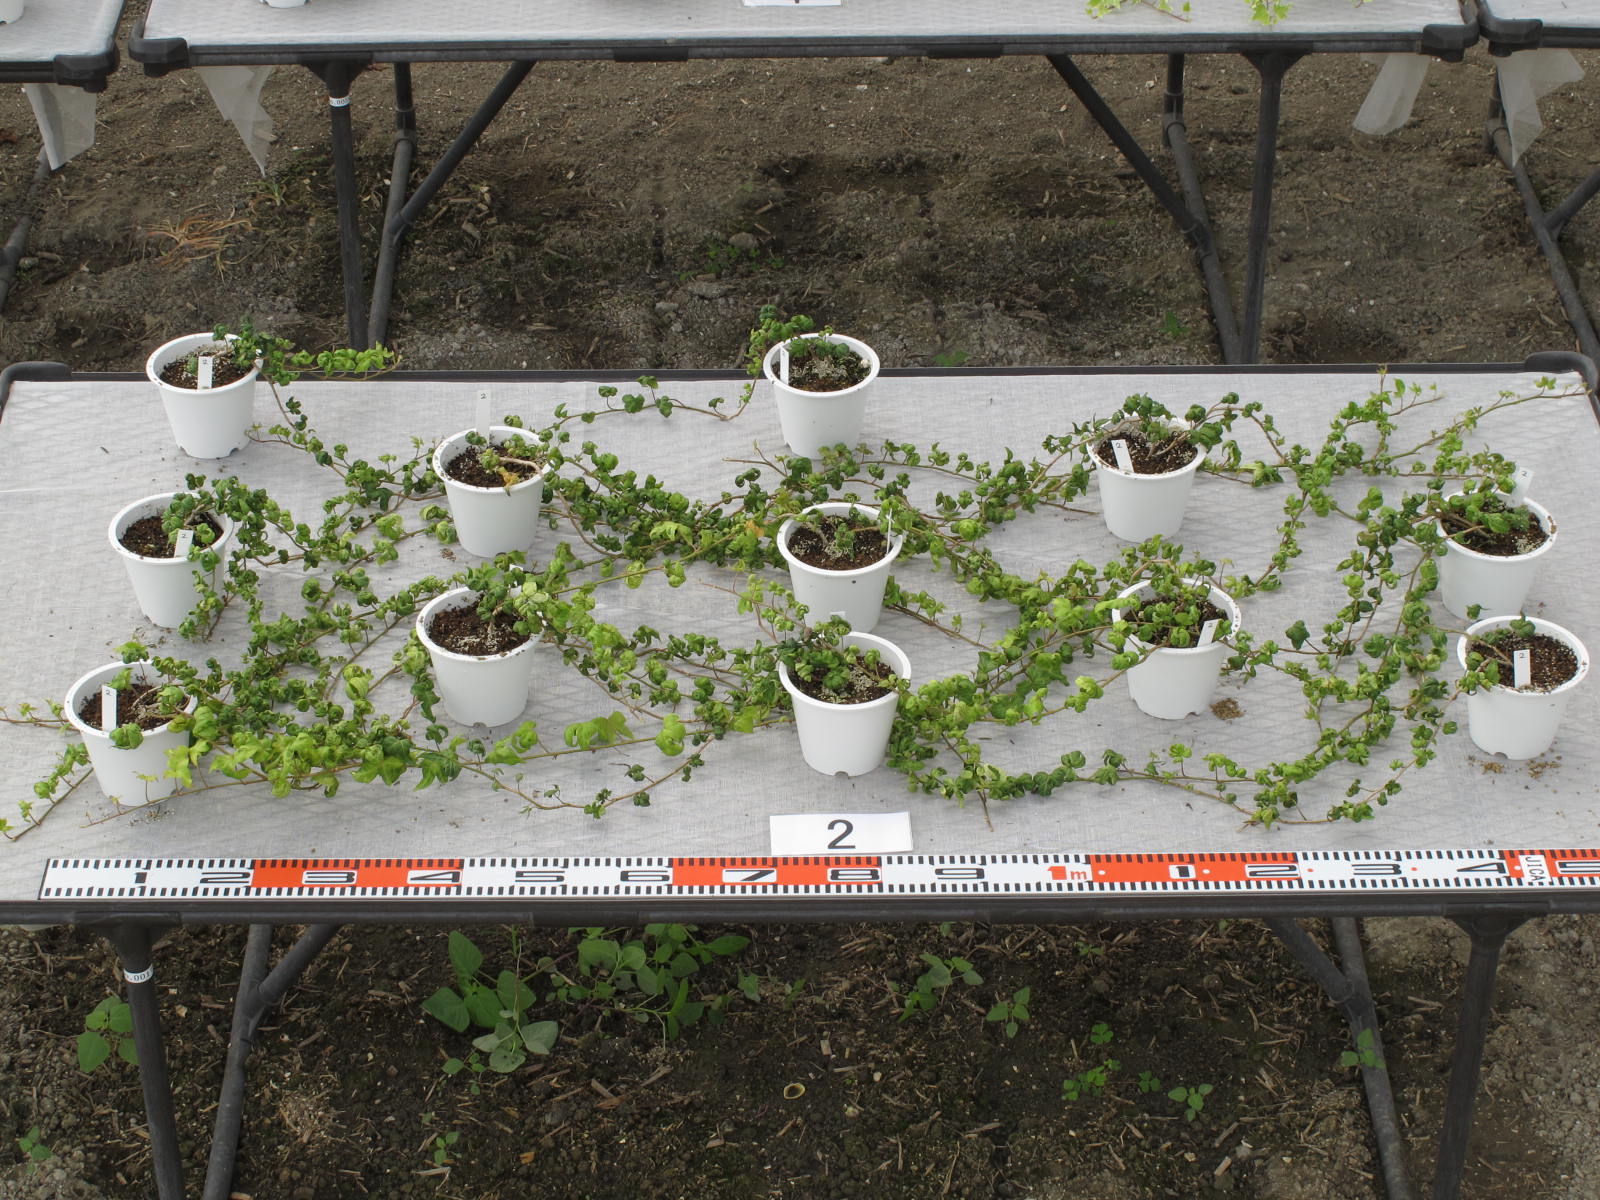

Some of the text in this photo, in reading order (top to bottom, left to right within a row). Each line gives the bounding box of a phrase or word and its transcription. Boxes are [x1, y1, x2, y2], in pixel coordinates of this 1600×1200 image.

[827, 818, 856, 850] 2
[134, 871, 147, 884] 1
[200, 871, 251, 884] 2
[304, 871, 355, 884] 3
[409, 870, 460, 883] 4
[515, 870, 565, 882] 5
[619, 870, 670, 882] 6
[725, 869, 775, 881] 7
[829, 868, 880, 881] 8
[934, 867, 985, 880] 9
[1047, 865, 1088, 880] 1m
[1175, 865, 1190, 878] 1
[1247, 865, 1299, 877] 2
[1351, 863, 1402, 875] 3
[1456, 862, 1506, 874] 4
[1525, 856, 1546, 882] JICA
